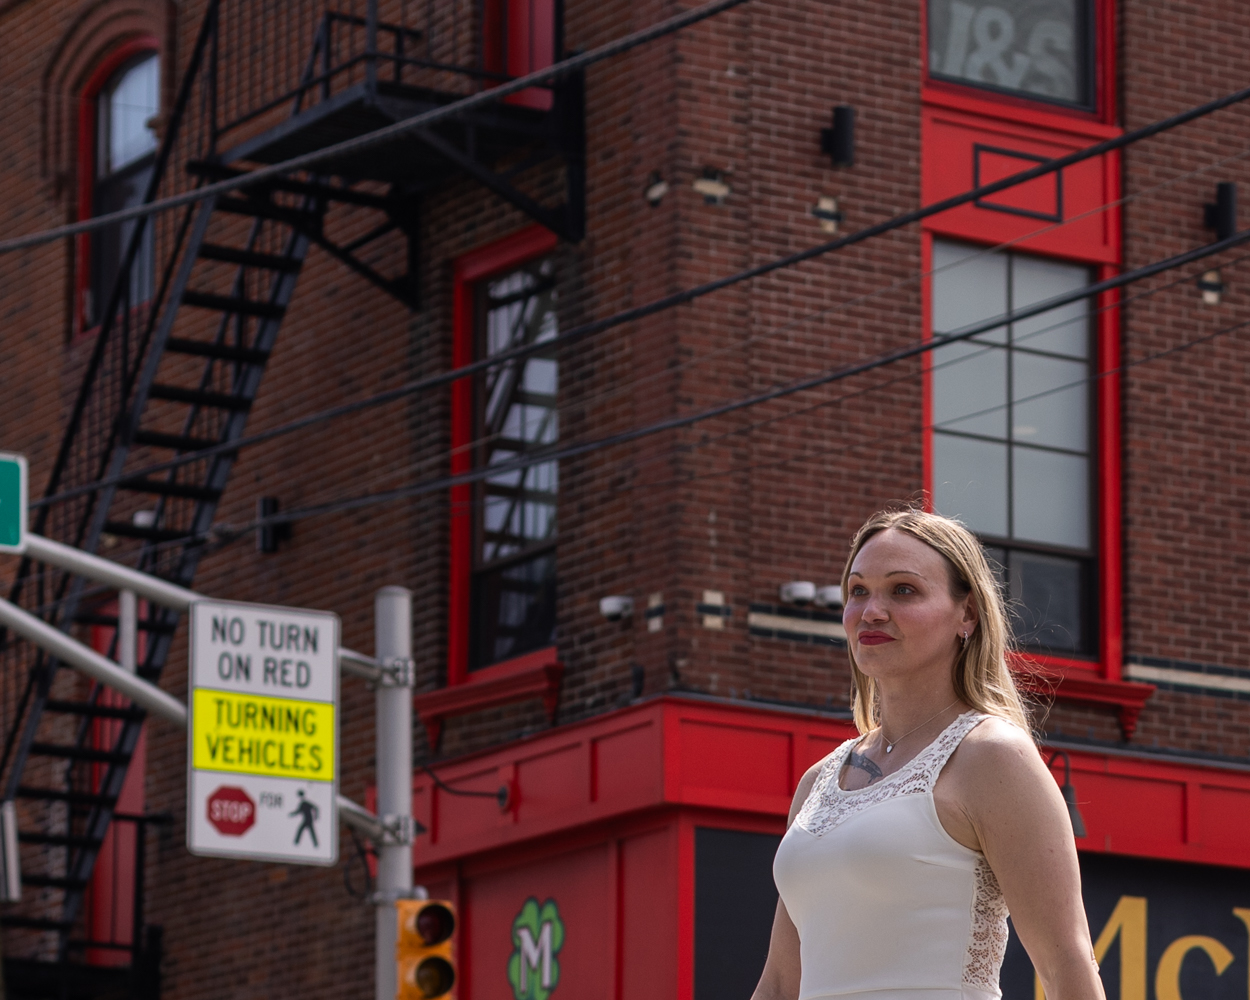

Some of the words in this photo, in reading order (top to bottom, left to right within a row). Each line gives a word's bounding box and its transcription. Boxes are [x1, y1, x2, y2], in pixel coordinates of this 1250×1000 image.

[211, 616, 245, 645] NO
[257, 620, 318, 653] TURN
[218, 651, 251, 681] ON
[263, 657, 311, 688] RED
[214, 698, 316, 736] TURNING
[206, 735, 322, 772] VEHICLES
[211, 799, 253, 823] STOP
[259, 792, 283, 808] FOR
[517, 921, 552, 994] M
